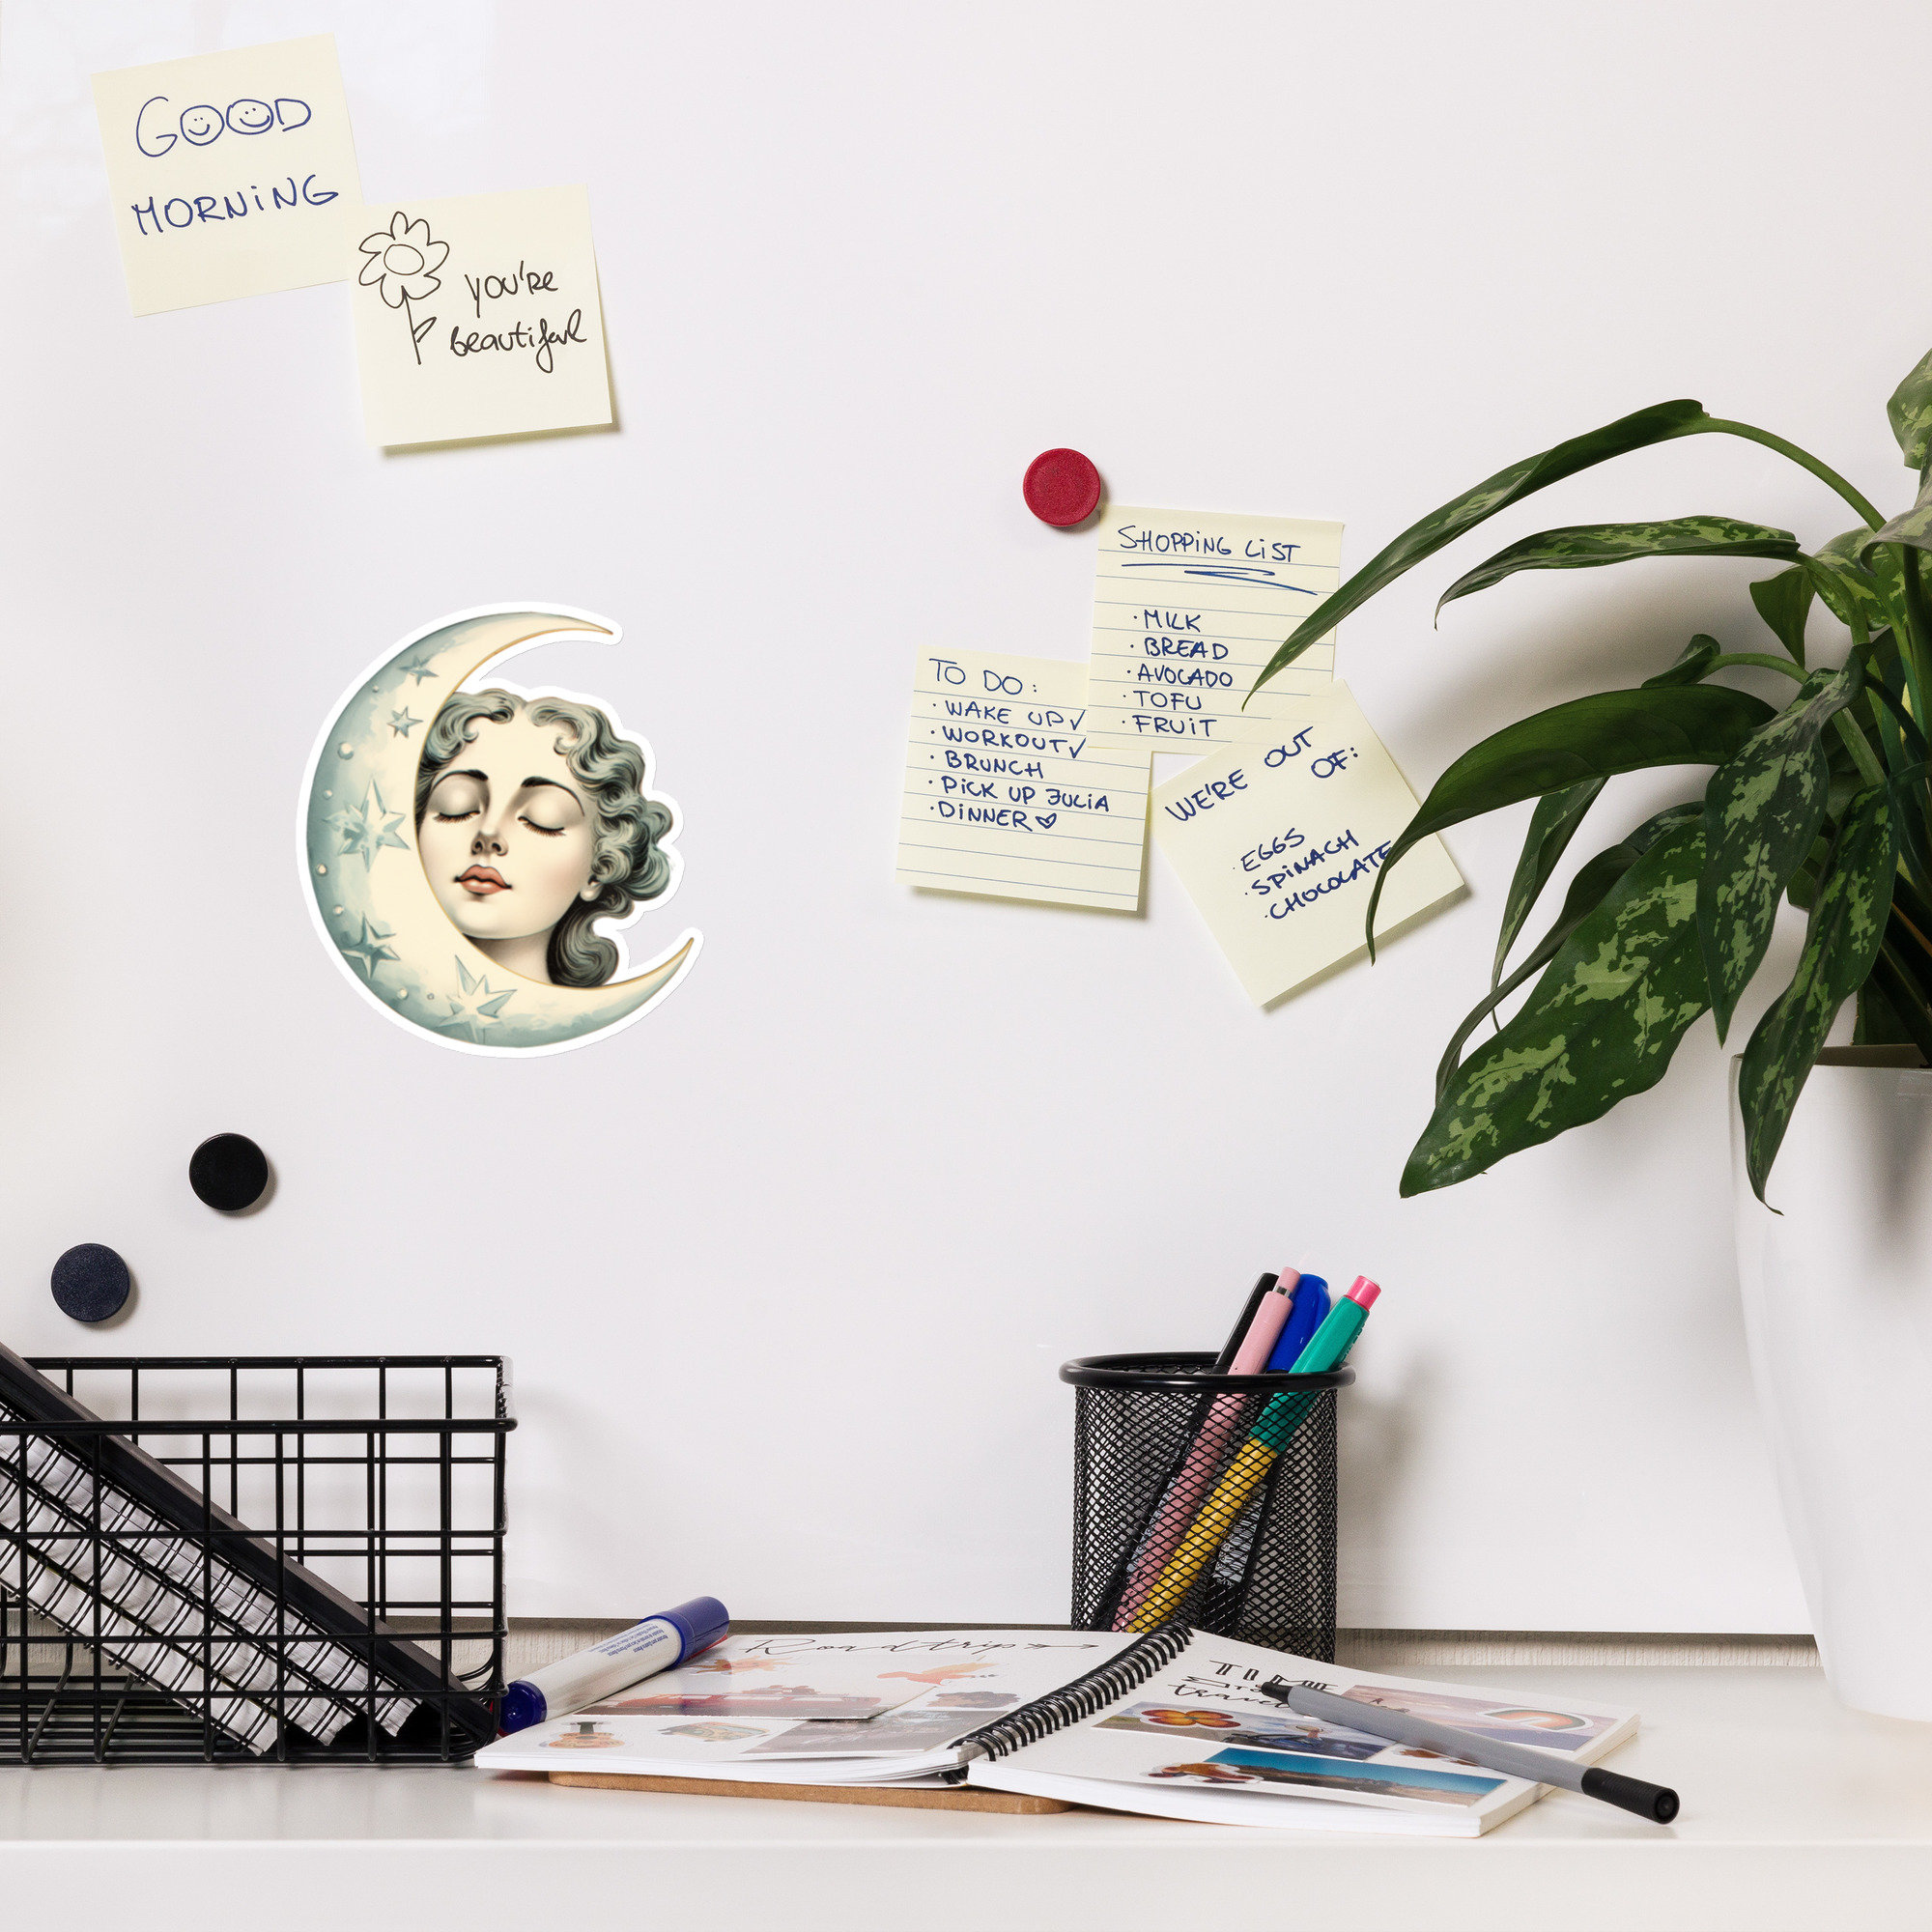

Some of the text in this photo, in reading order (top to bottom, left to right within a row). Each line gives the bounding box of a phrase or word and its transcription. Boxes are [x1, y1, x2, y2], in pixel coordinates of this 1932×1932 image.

[135, 96, 312, 157] GOOD
[1144, 609, 1202, 633] MILK
[1144, 636, 1229, 661] BREAD
[928, 658, 966, 686] TO
[1137, 663, 1234, 689] AVOCADO
[945, 699, 1065, 727] WAKE UP
[1132, 690, 1203, 711] TOFU
[942, 725, 1068, 753] WORKOUT
[1264, 725, 1317, 770] OUT
[944, 750, 1044, 779] BRUNCH
[1009, 785, 1037, 806] UP
[1240, 827, 1307, 874] EGGS
[1267, 838, 1392, 920] CHOCOLATE
